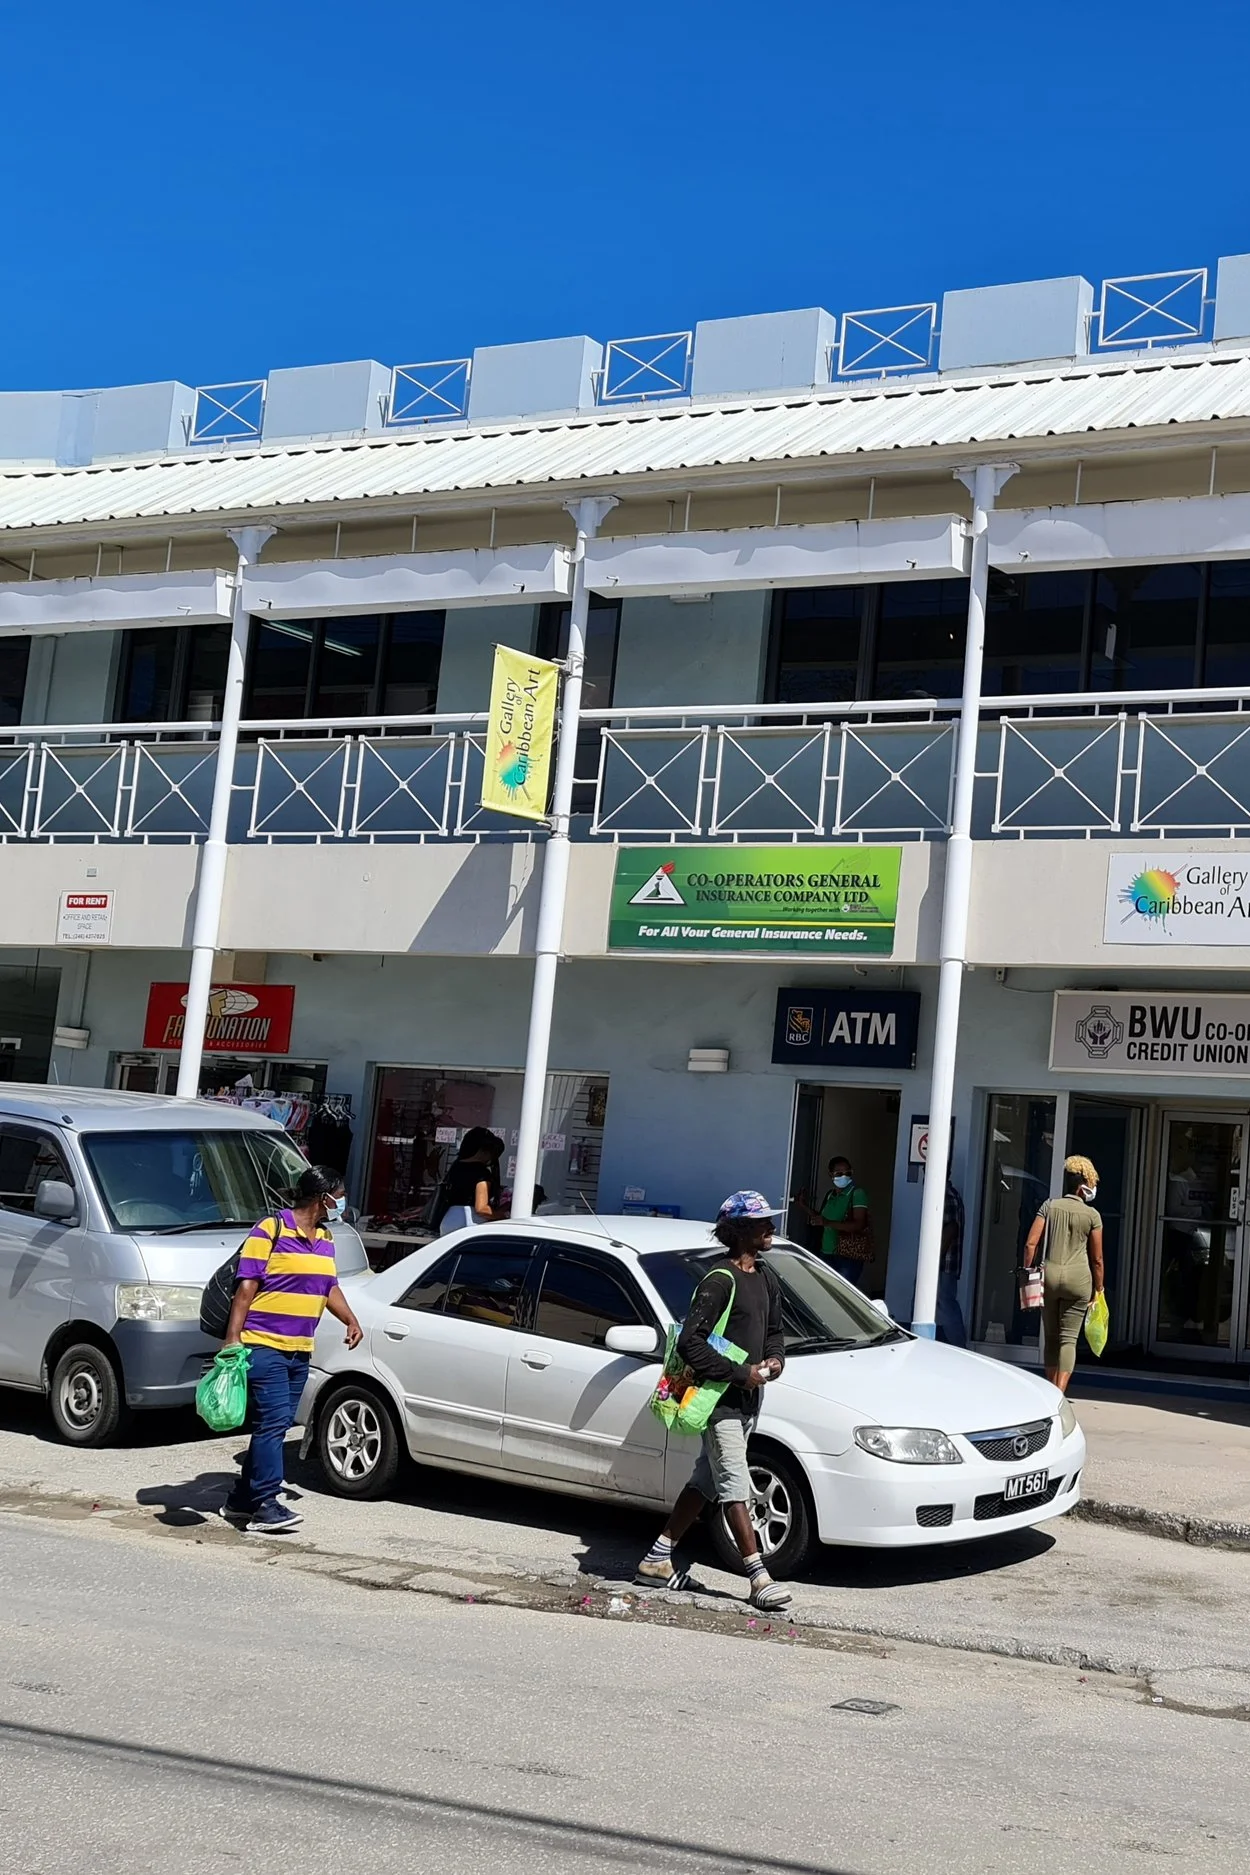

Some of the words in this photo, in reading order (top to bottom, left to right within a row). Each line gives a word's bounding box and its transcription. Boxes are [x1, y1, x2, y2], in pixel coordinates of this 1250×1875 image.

[523, 667, 541, 702] Art
[500, 677, 521, 734] Gallery
[515, 695, 523, 706] of
[514, 703, 535, 786] Caribbean
[687, 873, 804, 888] CO-OPERATORS
[807, 874, 881, 888] GENERAL
[1186, 866, 1248, 891] Gallery
[1219, 884, 1232, 895] of
[68, 897, 84, 905] FOR
[85, 897, 106, 905] RENT
[695, 889, 771, 903] INSURANCE
[773, 890, 841, 903] COMPANY
[843, 891, 869, 903] LTD
[1135, 895, 1224, 915] Caribbean
[638, 926, 660, 937] For
[661, 926, 678, 938] All
[681, 926, 710, 938] Your
[711, 927, 758, 939] General
[761, 928, 822, 940] Insurance
[825, 929, 868, 941] Needs.
[788, 1033, 809, 1042] RBC
[828, 1011, 896, 1045] ATM
[1128, 1005, 1202, 1040] BWU
[1126, 1042, 1189, 1062] CREDIT
[1193, 1044, 1248, 1064] UNION
[1007, 1472, 1047, 1498] MT561
